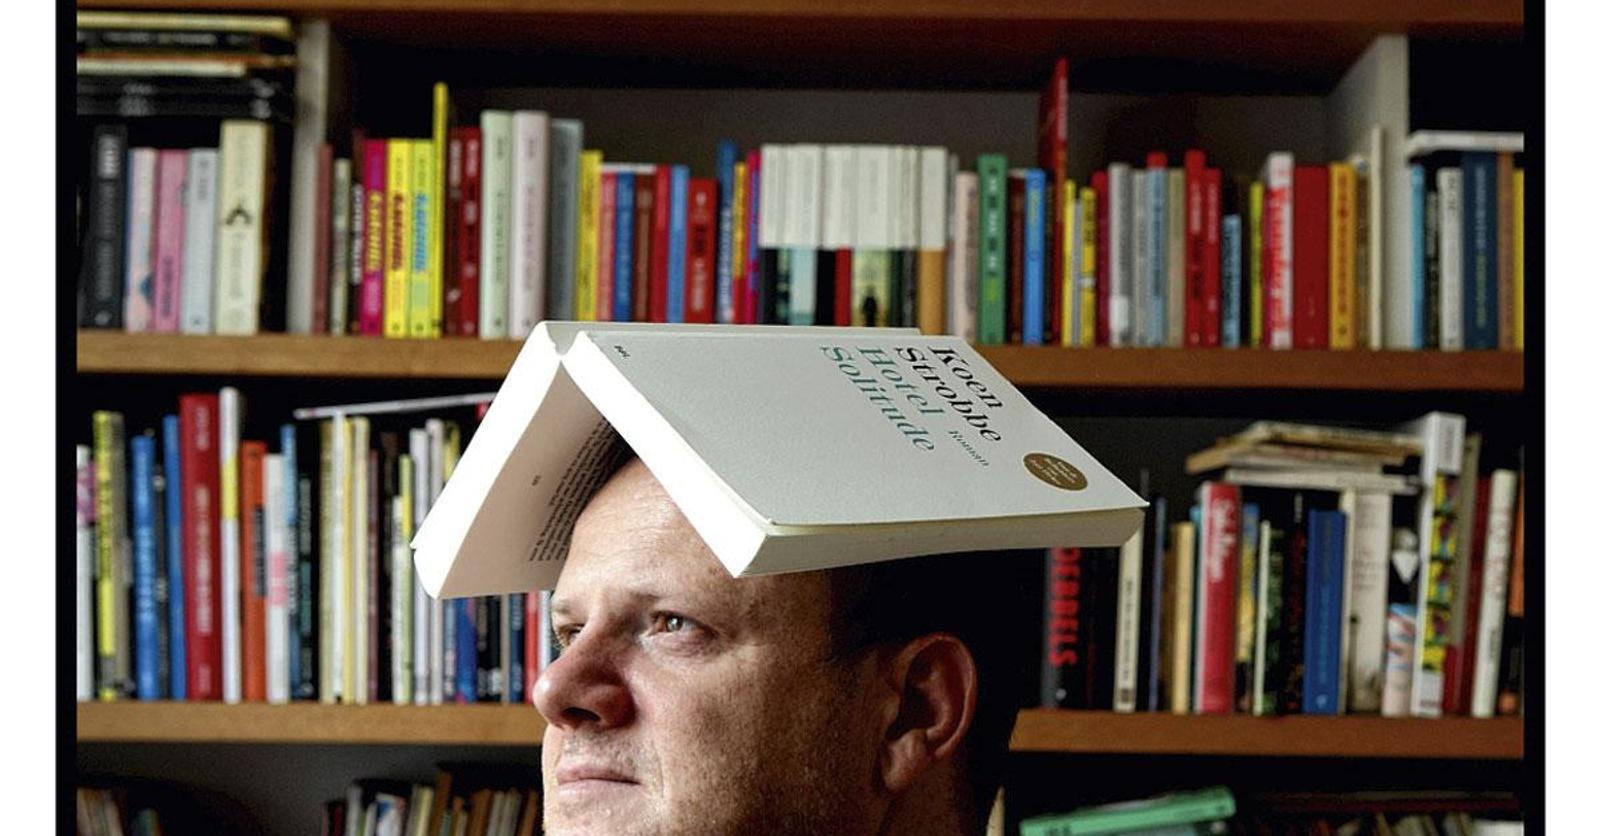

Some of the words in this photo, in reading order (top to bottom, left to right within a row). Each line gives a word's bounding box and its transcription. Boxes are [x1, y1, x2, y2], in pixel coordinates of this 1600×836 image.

[819, 346, 935, 451] Solitude
[855, 346, 945, 414] Hotel
[894, 346, 1002, 442] Strobbe
[927, 346, 1003, 409] Koen
[948, 430, 990, 466] Roman
